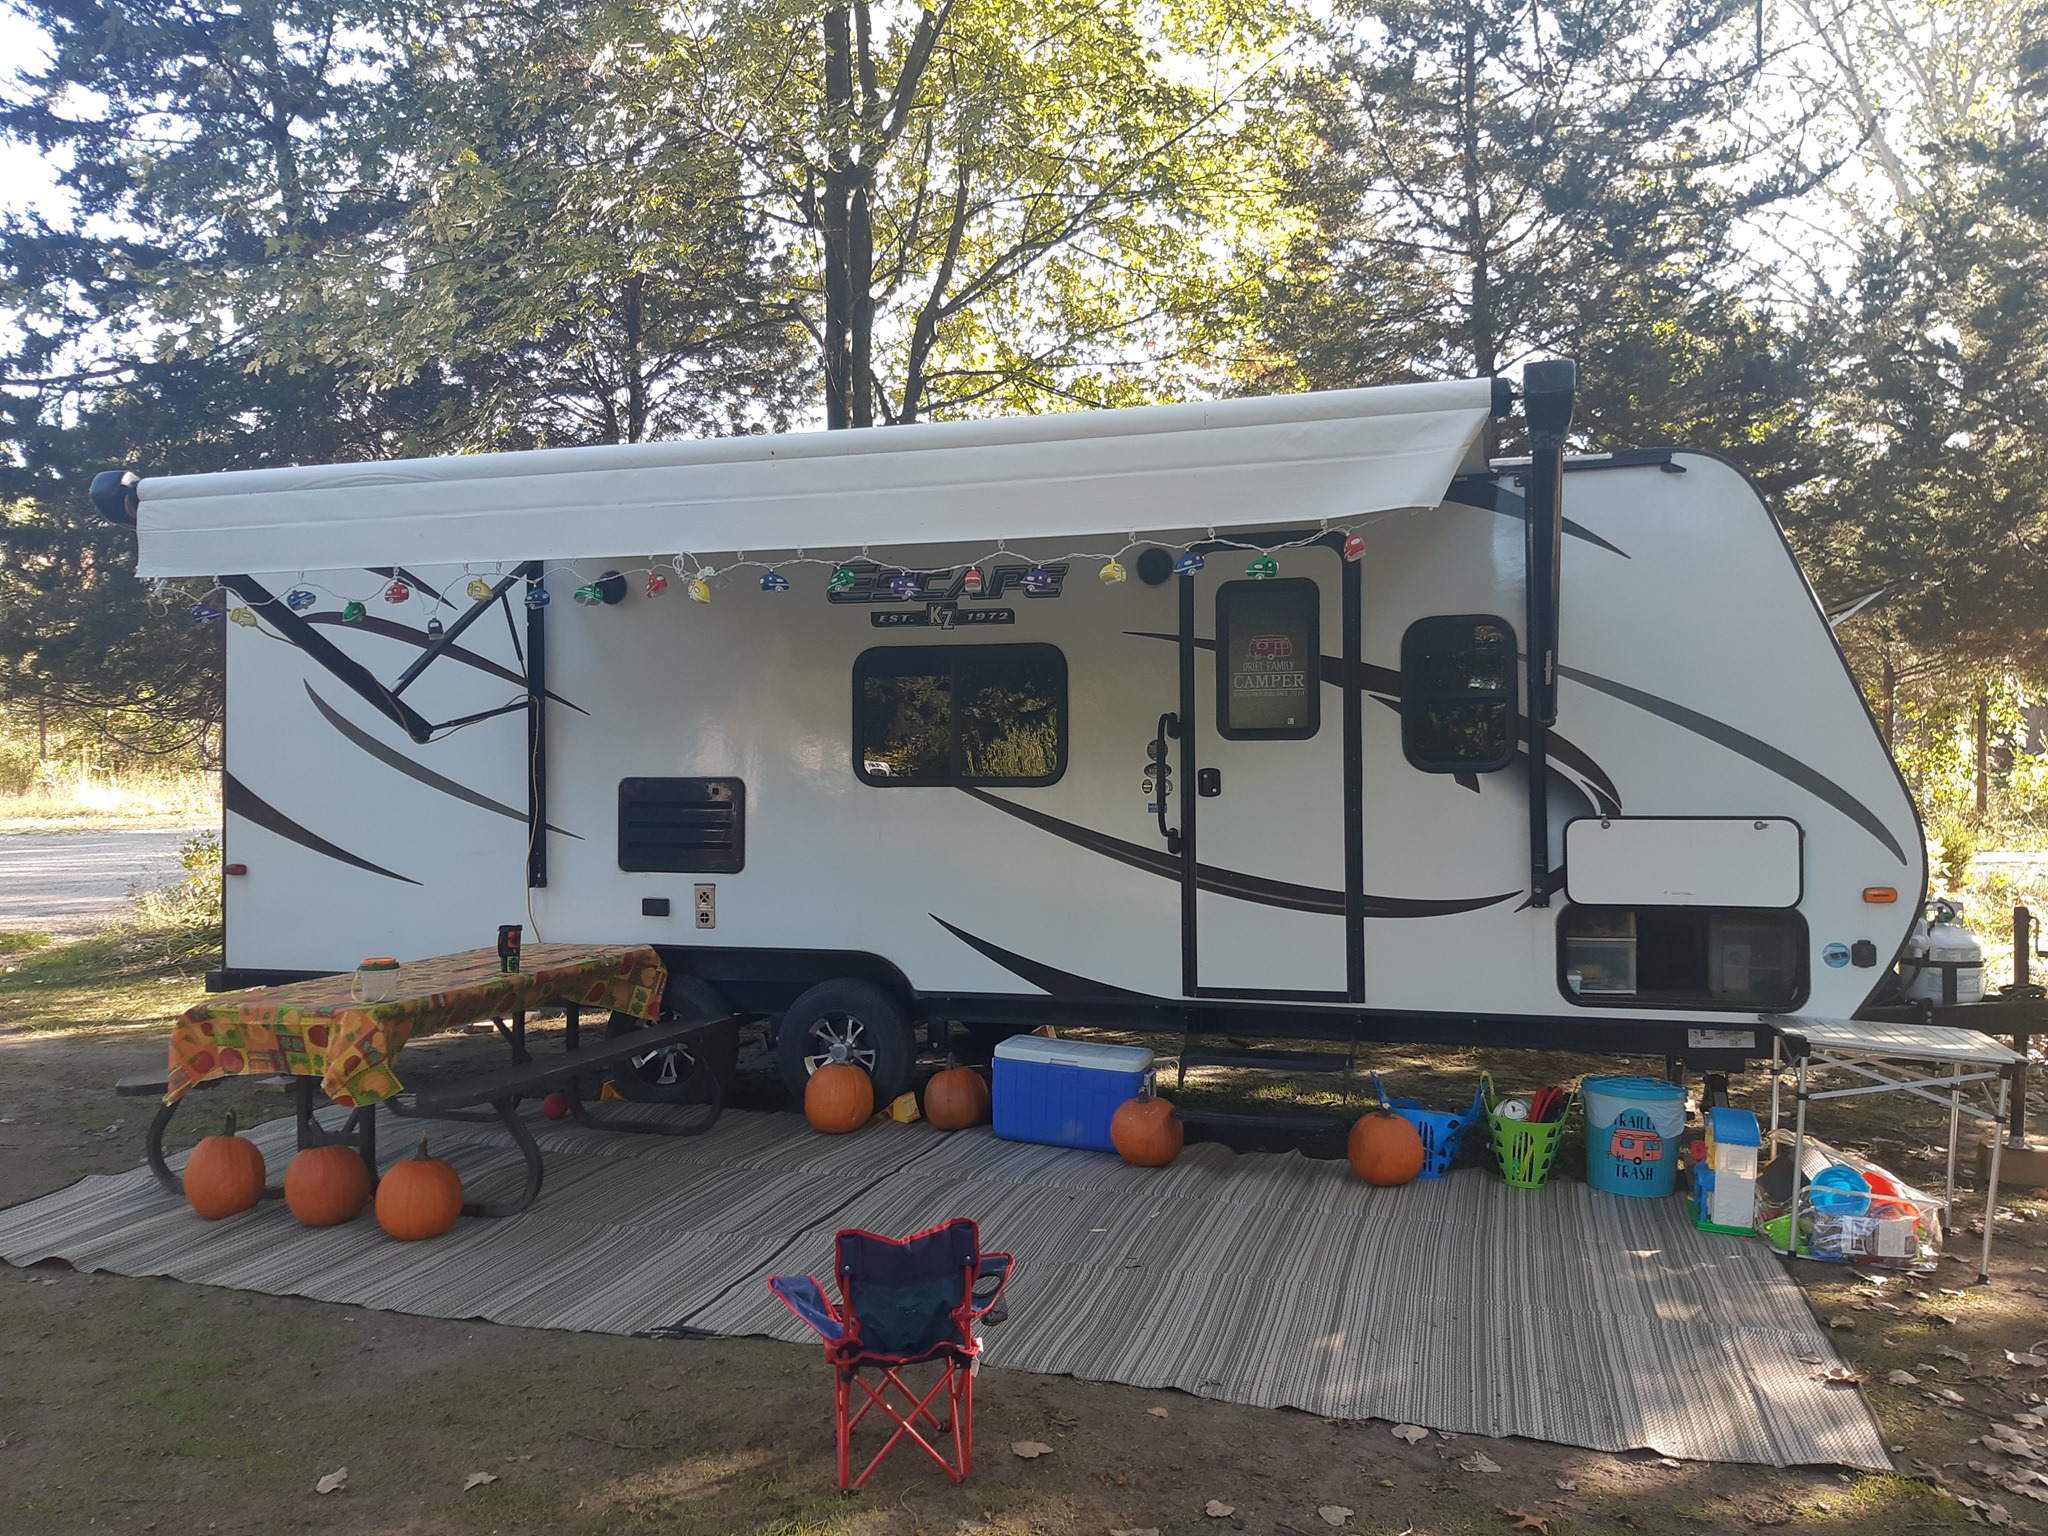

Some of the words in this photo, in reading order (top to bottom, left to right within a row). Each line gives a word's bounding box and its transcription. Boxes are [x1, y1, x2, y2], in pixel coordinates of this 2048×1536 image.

[879, 614, 915, 623] EST.
[929, 604, 955, 630] KZ
[967, 612, 1009, 621] 1972
[1266, 660, 1294, 671] FAMILY
[1233, 673, 1305, 689] CAMPER
[1614, 1113, 1656, 1130] RAILE
[1615, 1163, 1654, 1180] TRASH
